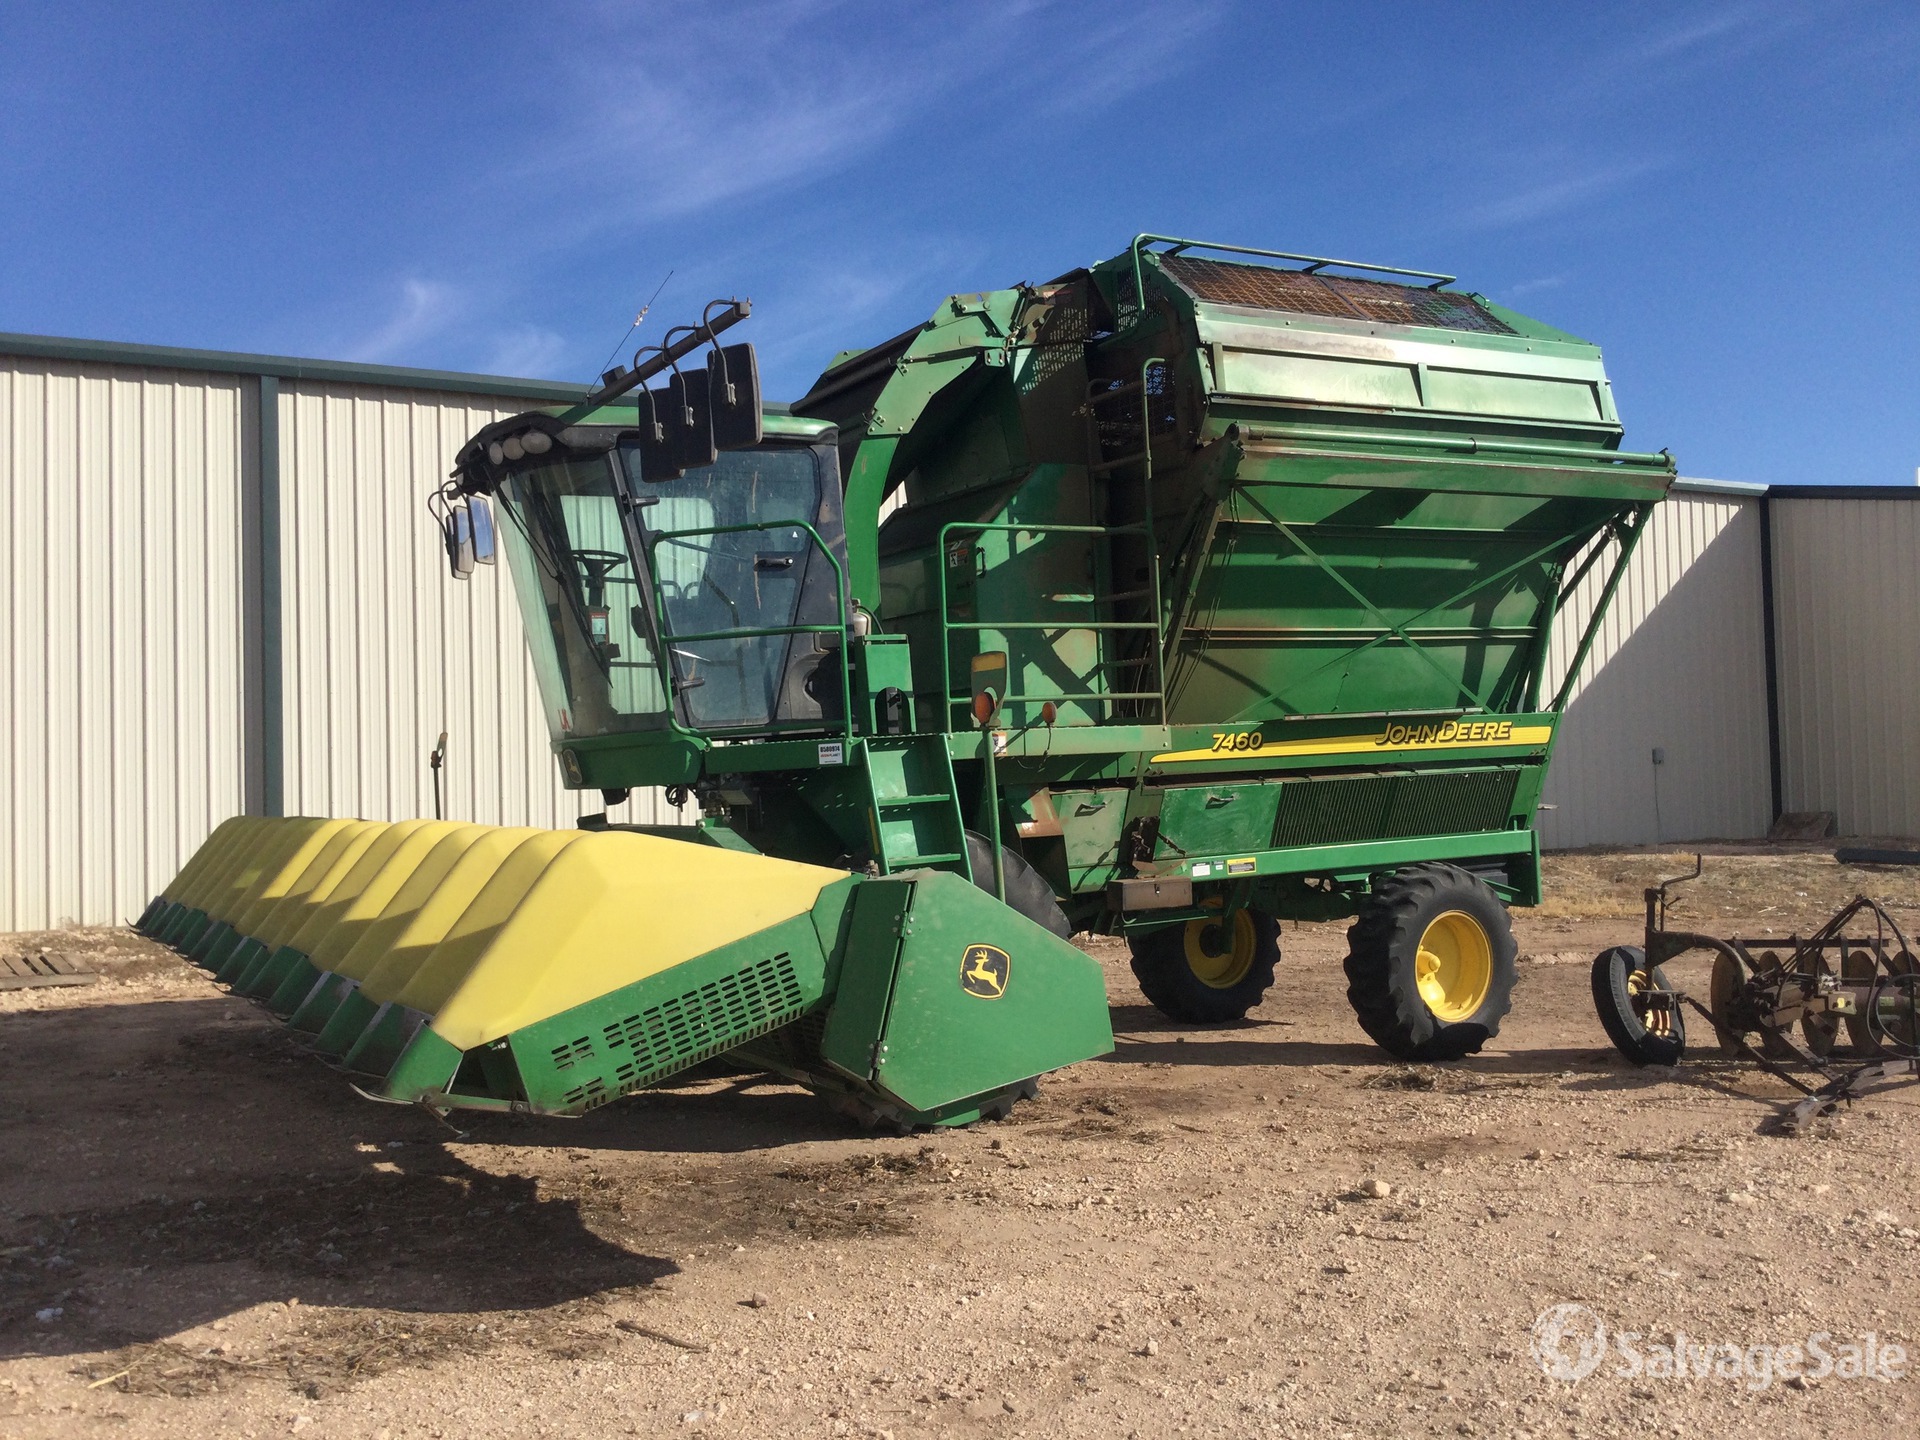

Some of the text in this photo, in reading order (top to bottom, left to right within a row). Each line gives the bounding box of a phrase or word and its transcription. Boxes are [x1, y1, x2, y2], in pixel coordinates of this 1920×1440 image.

[1211, 731, 1263, 752] 7460
[1374, 720, 1513, 745] JOHN DEERE
